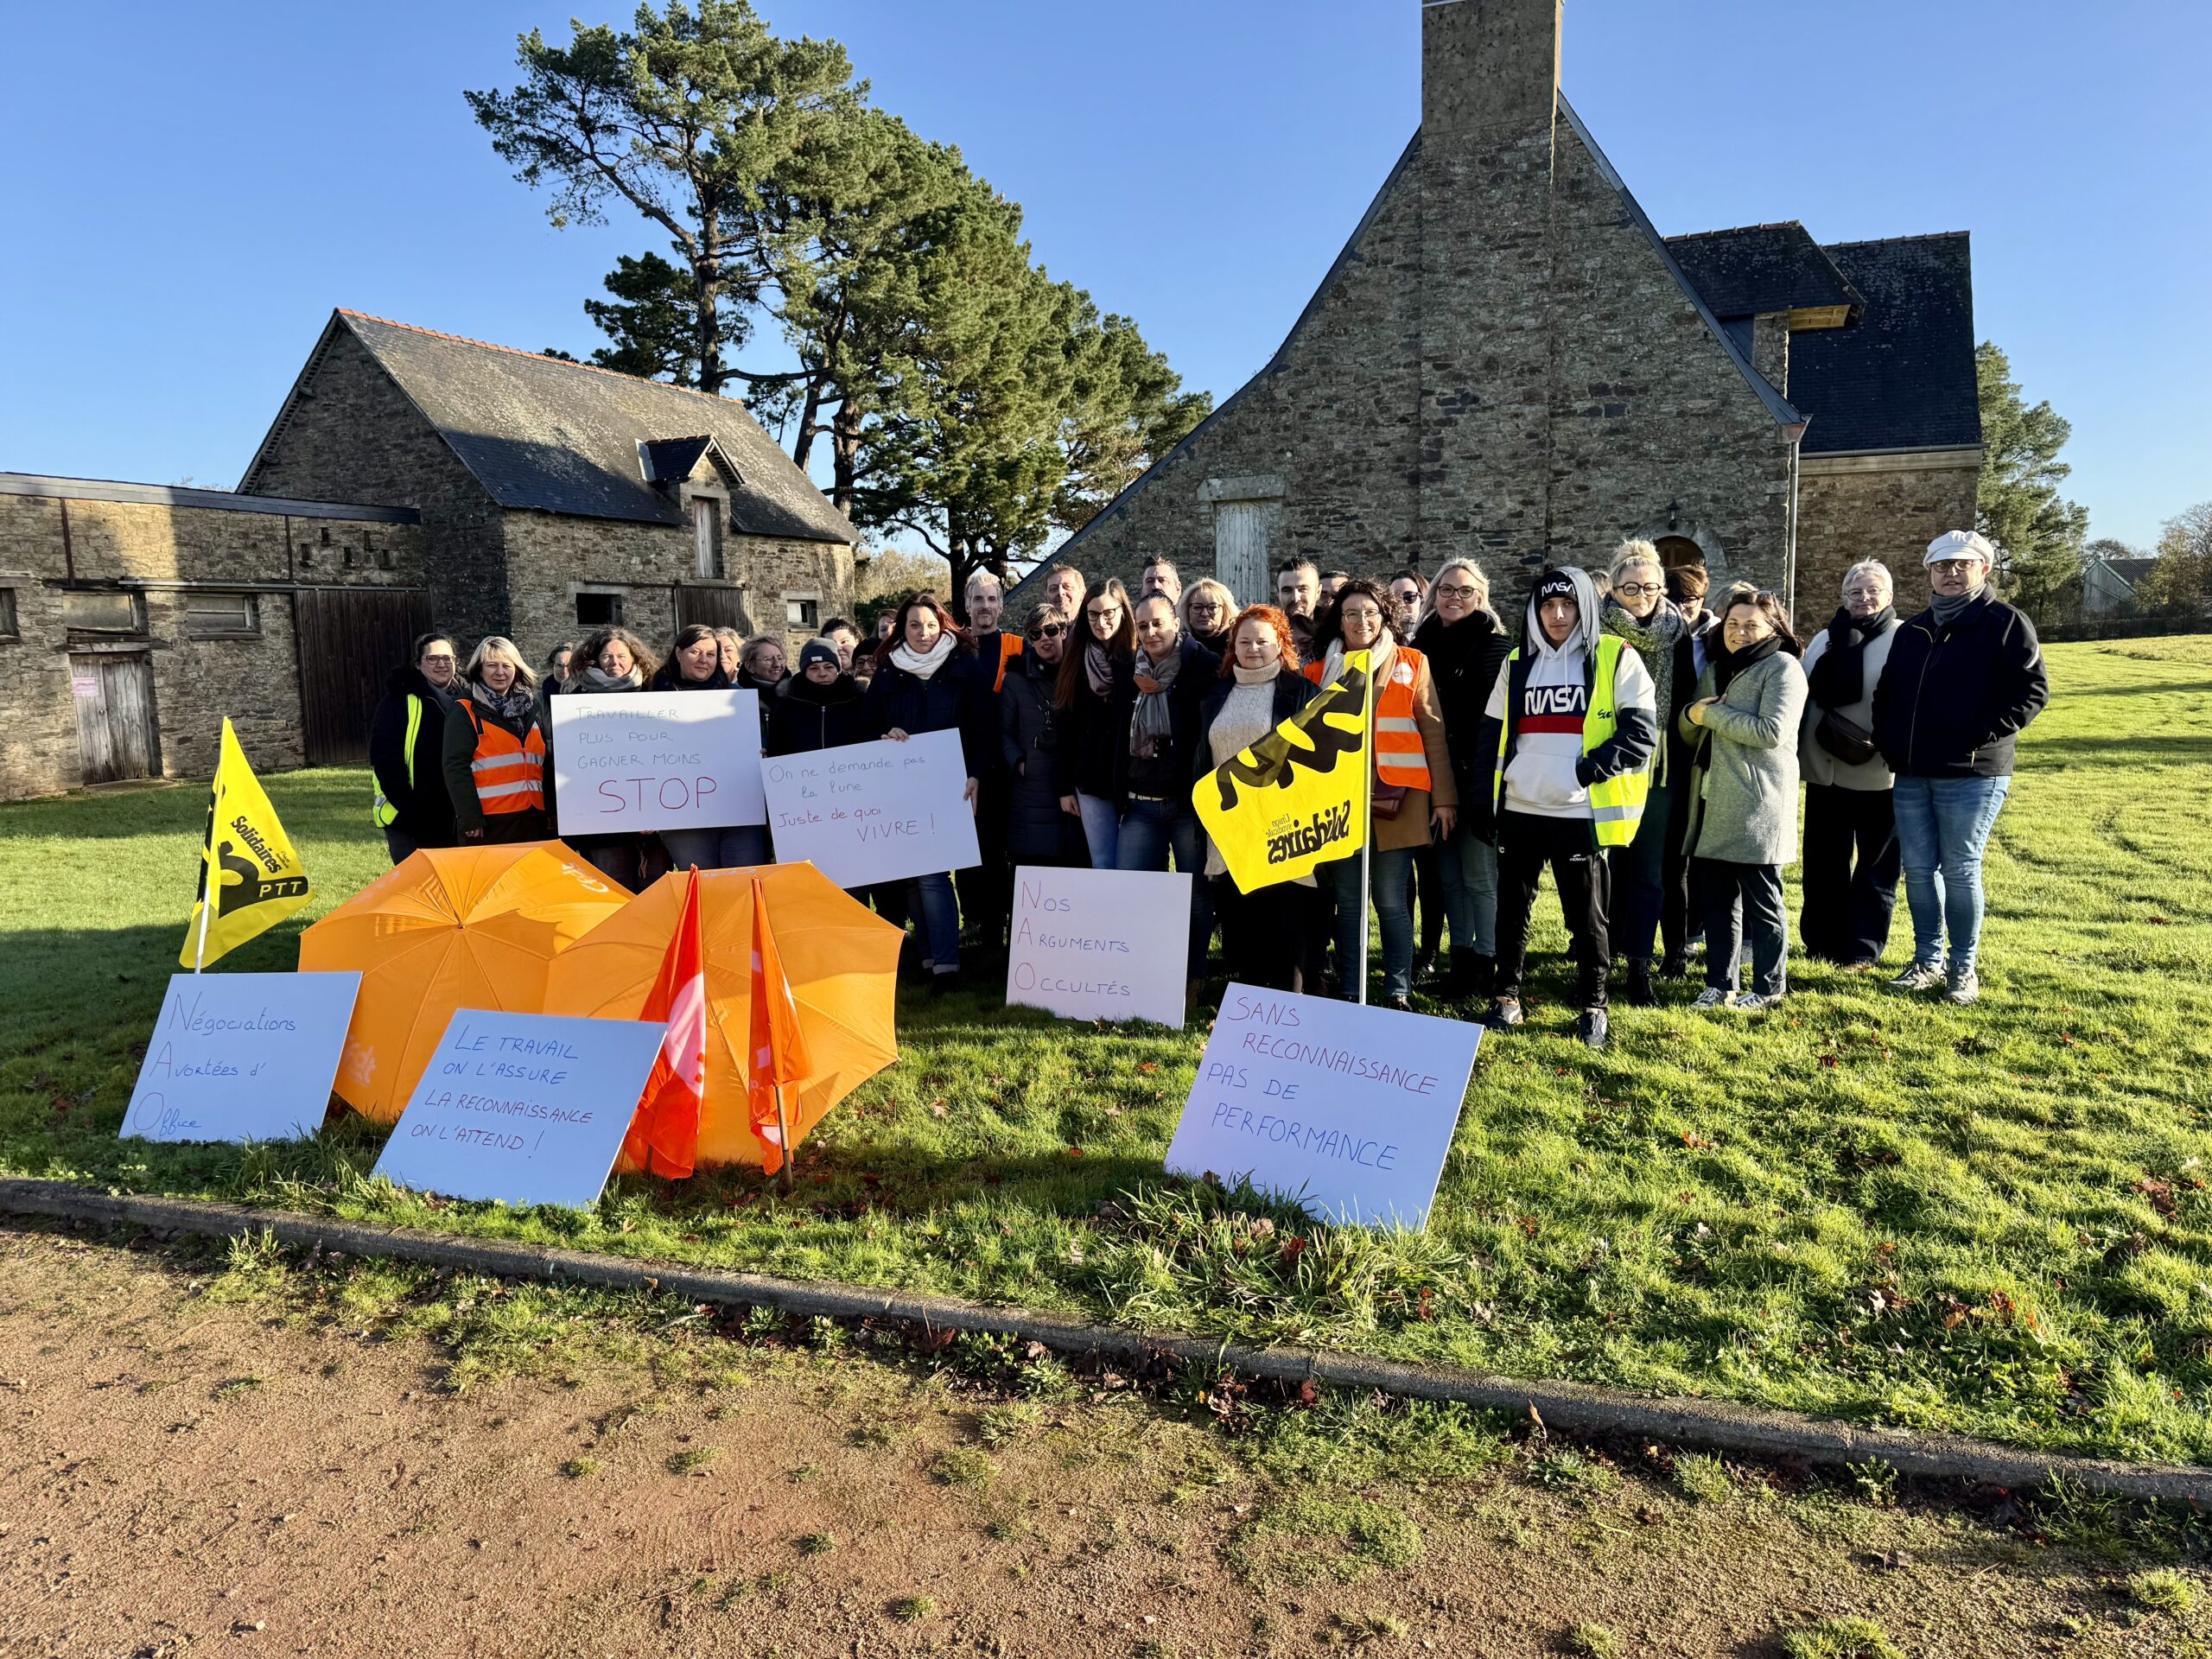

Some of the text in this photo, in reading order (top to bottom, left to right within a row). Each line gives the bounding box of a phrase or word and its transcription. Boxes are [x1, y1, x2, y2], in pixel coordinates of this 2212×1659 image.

[1541, 582, 1576, 597] NASA
[1525, 686, 1586, 715] NASA
[575, 707, 679, 720] TRAVAILLER
[580, 732, 674, 744] PLUS POUR
[577, 753, 702, 769] GAGNER MOINS
[769, 755, 926, 783] On ne demande pas
[598, 777, 717, 813] STOP
[801, 780, 862, 798] la lune
[777, 807, 882, 828] Juste de quoi
[230, 816, 283, 874] Solidaires
[259, 881, 302, 898] PTT
[168, 991, 296, 1036] Négociations
[1227, 996, 1301, 1027] SANS
[499, 1037, 579, 1059] TRAVAIL
[442, 1062, 568, 1084] ON L'ASSURE
[1207, 1063, 1300, 1100] PAS DE
[424, 1089, 451, 1107] LA
[133, 1091, 202, 1136] Office
[410, 1124, 435, 1137] ON
[1211, 1103, 1399, 1171] PERFORMANCE
